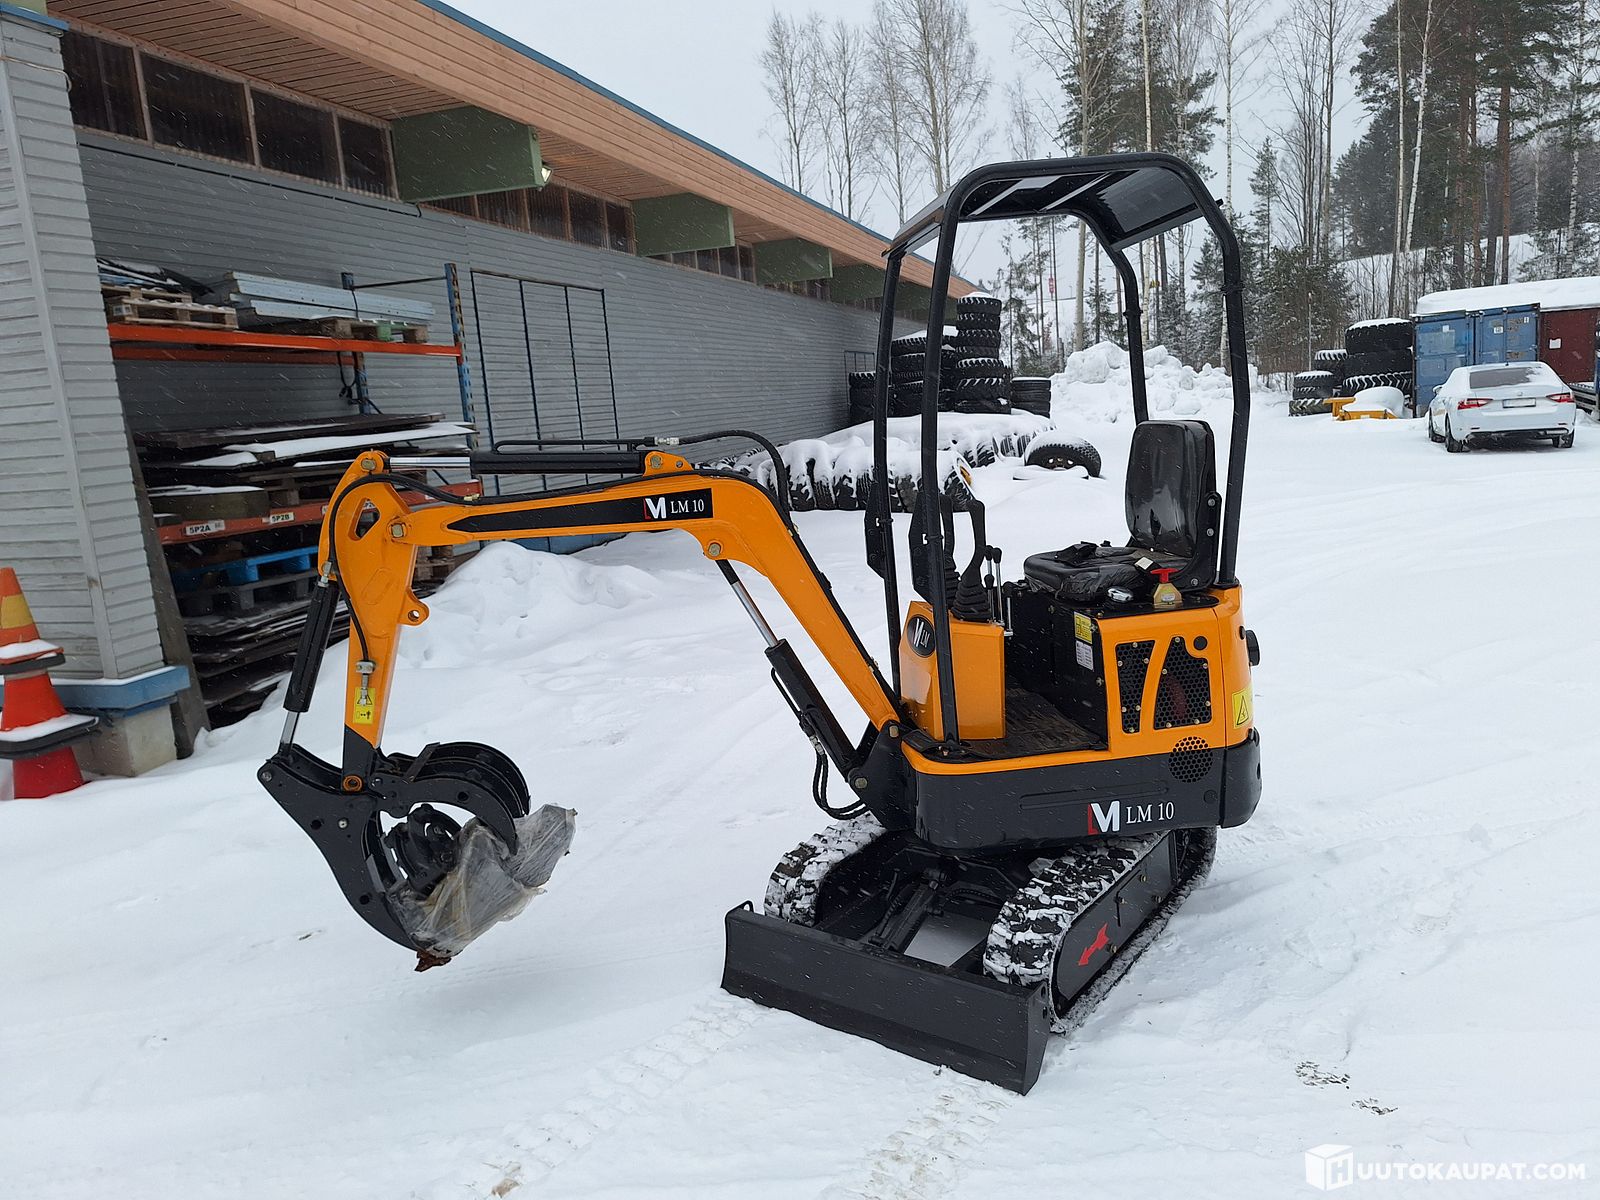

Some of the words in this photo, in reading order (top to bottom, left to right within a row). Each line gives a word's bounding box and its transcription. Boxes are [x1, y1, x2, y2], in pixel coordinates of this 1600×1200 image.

[671, 500, 689, 514] LM
[693, 499, 705, 512] 10
[189, 525, 211, 534] 5P2A
[1126, 804, 1153, 824] LM
[1158, 801, 1175, 821] 10
